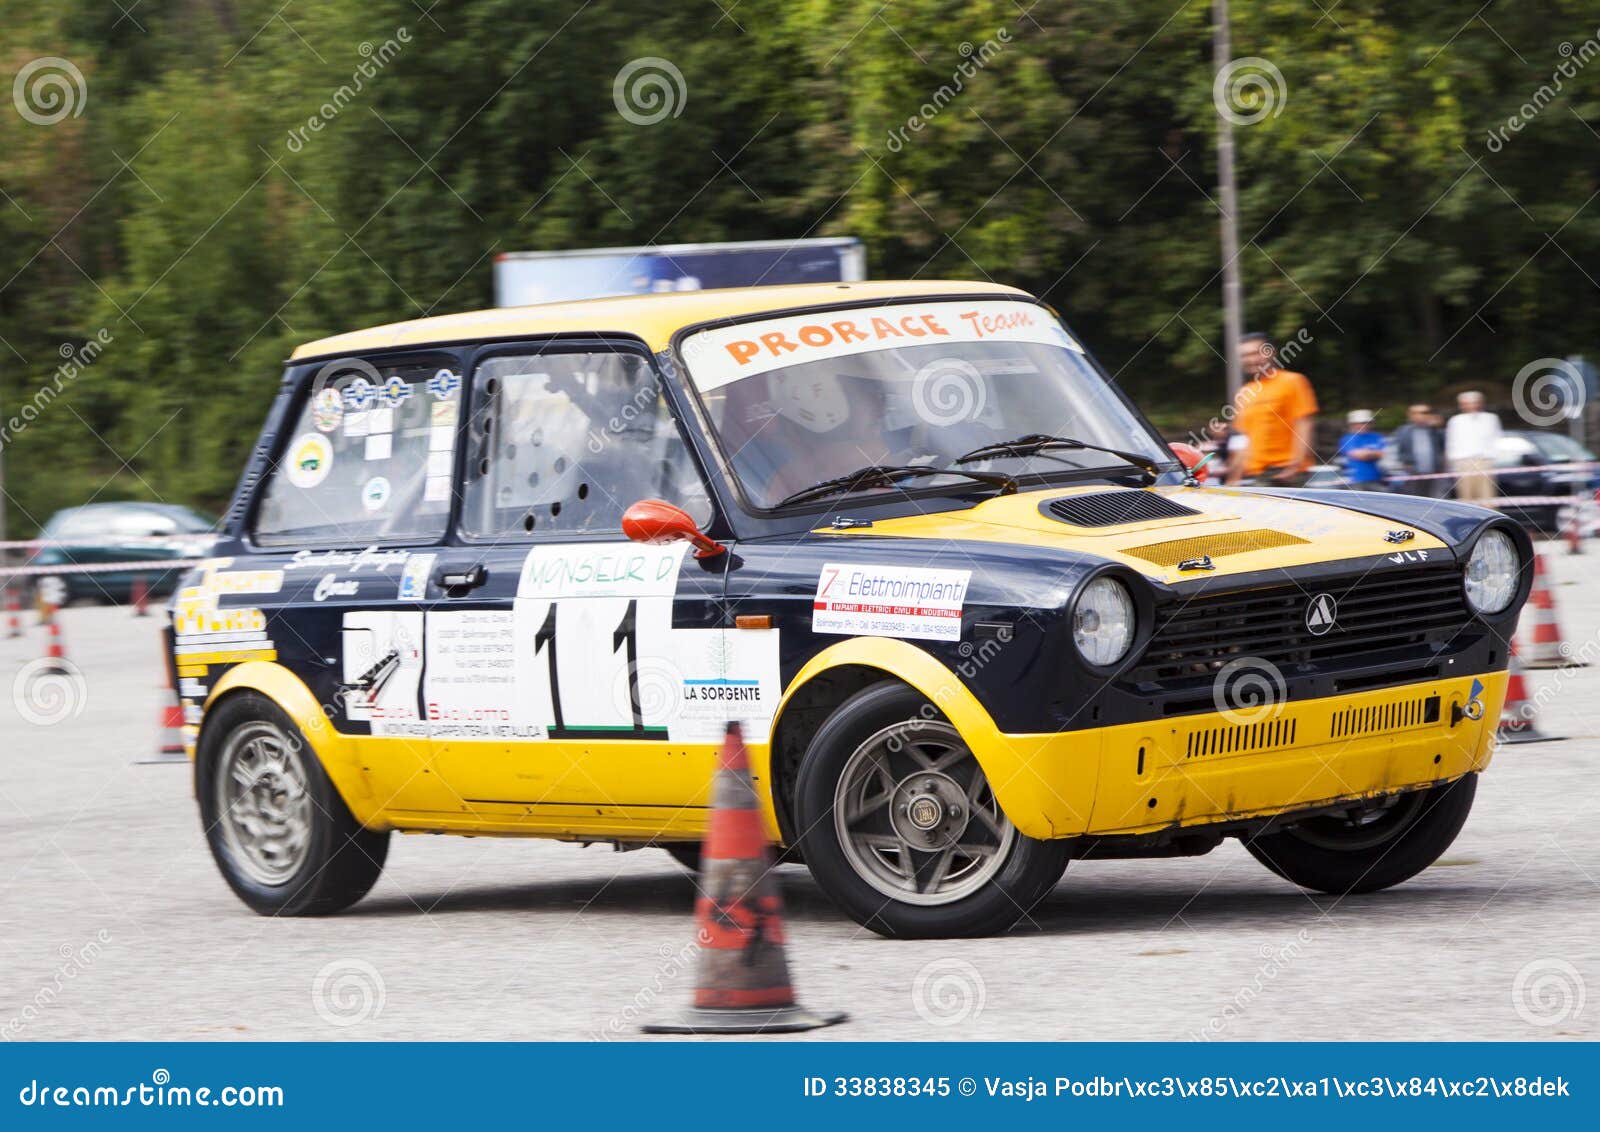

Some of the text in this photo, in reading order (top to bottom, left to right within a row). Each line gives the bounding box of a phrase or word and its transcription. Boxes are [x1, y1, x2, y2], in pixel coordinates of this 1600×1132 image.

[725, 309, 1035, 365] PRORACE Team
[848, 572, 967, 605] Elettroimpianti
[683, 687, 760, 701] LA SORGENTE
